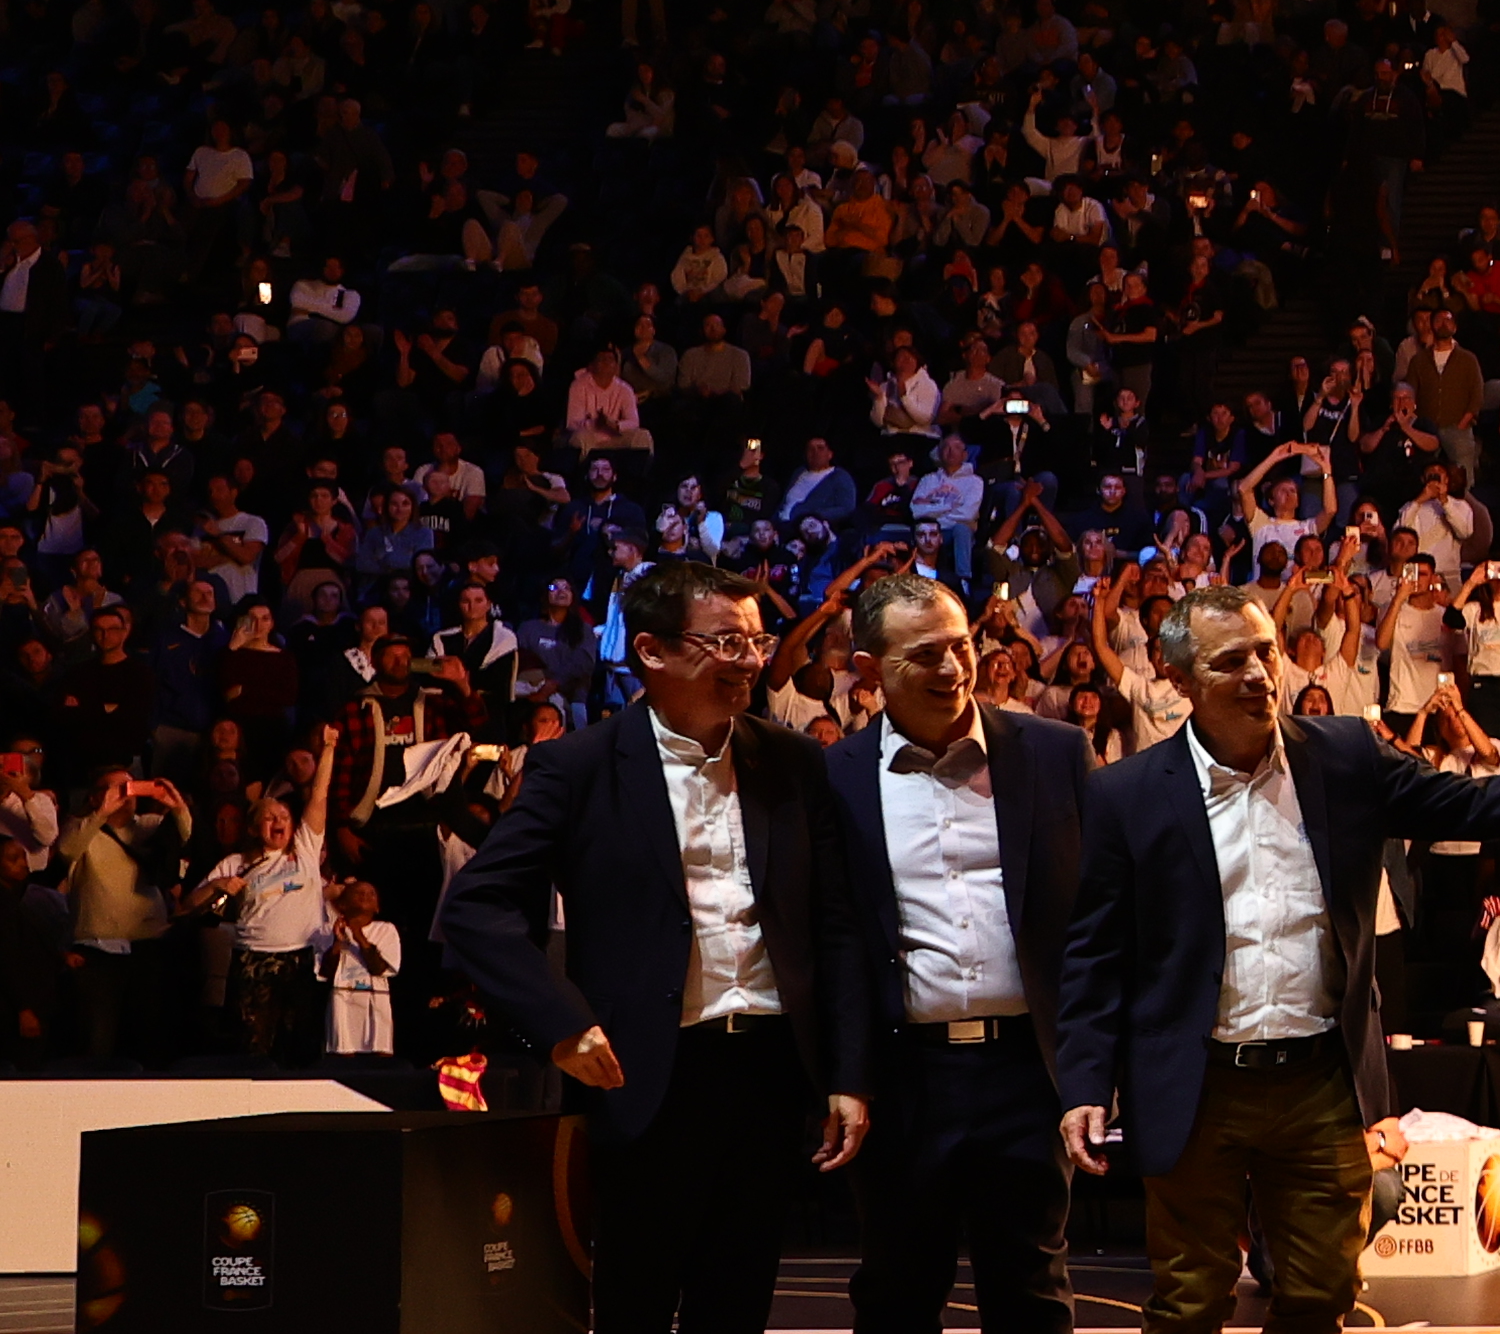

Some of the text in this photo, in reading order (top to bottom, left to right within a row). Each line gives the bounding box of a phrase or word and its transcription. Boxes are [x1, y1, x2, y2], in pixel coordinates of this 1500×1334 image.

[1440, 1169, 1459, 1183] DE
[1399, 1185, 1455, 1204] NCE
[1399, 1238, 1434, 1255] FFBB
[211, 1256, 254, 1267] COUPE
[213, 1266, 262, 1277] FRANCE
[220, 1276, 266, 1286] BASKET
